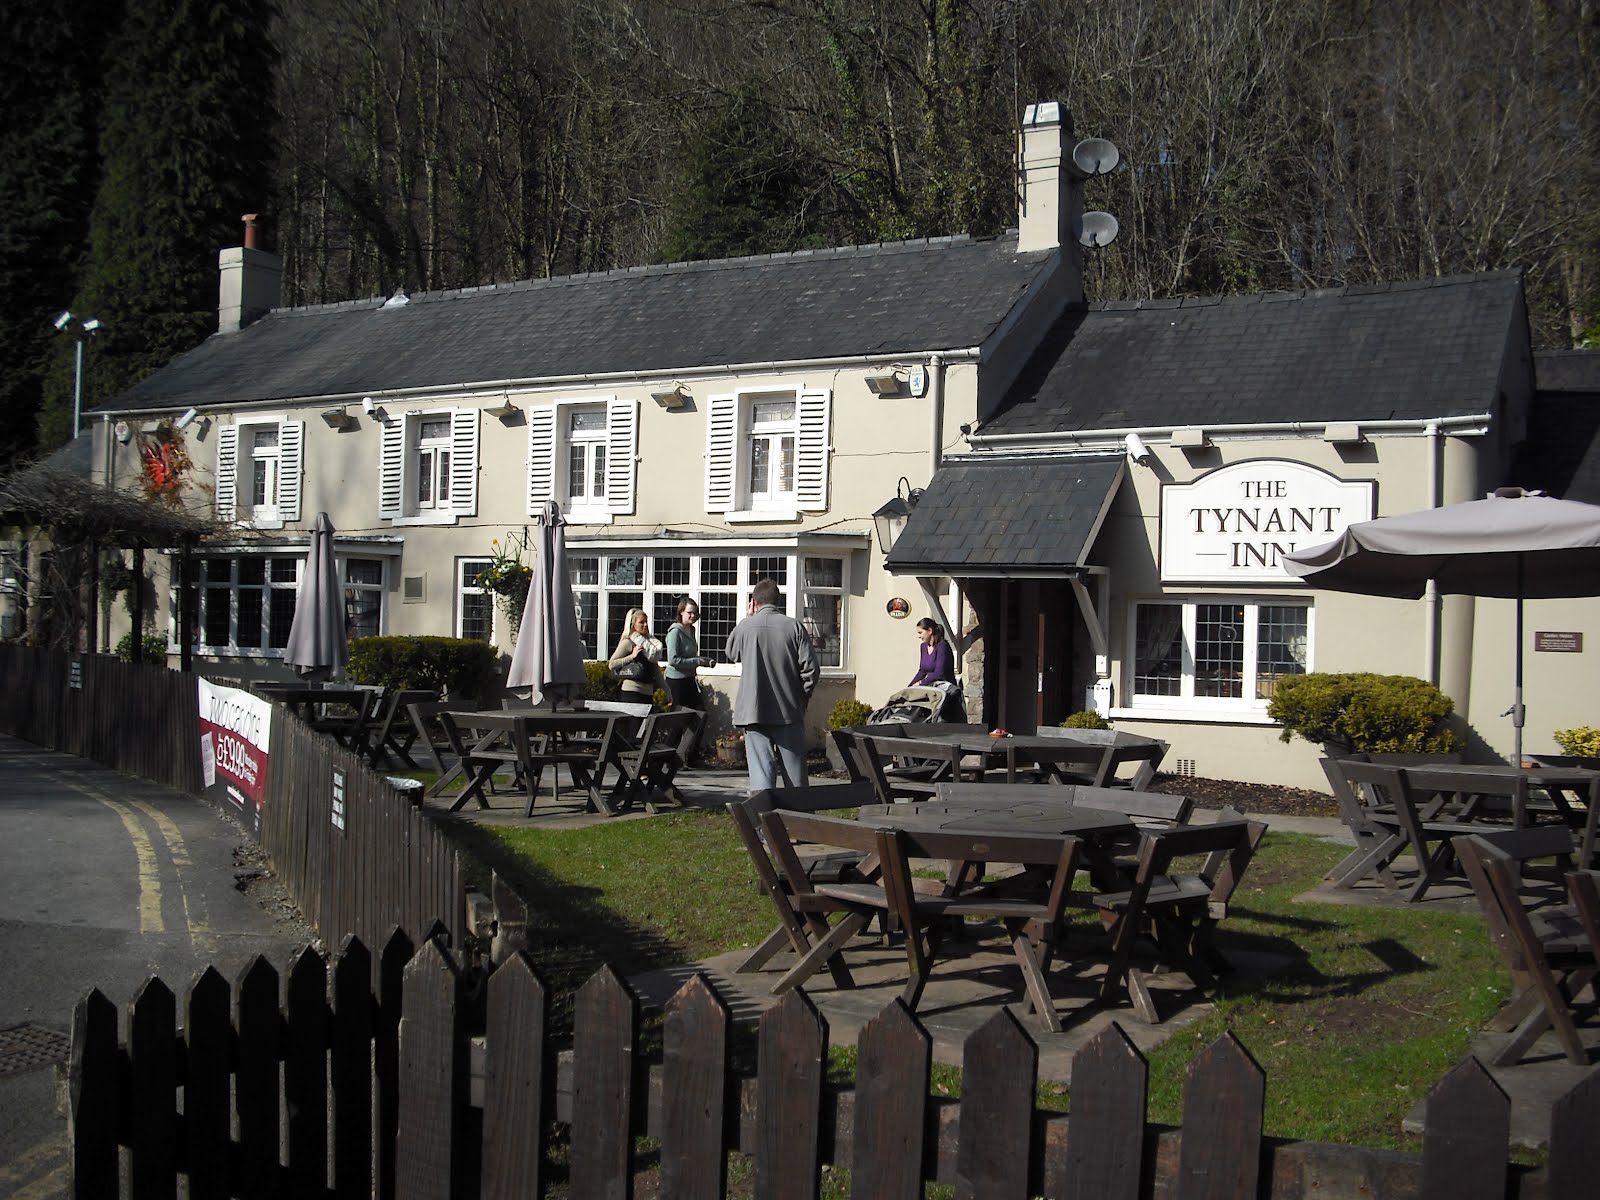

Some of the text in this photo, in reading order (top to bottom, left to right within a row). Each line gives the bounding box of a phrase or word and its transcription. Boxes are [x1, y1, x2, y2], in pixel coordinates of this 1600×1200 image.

[1241, 480, 1287, 498] THE
[1189, 507, 1341, 533] TYNANT
[1231, 542, 1297, 568] INN
[223, 735, 246, 780] £9.99
